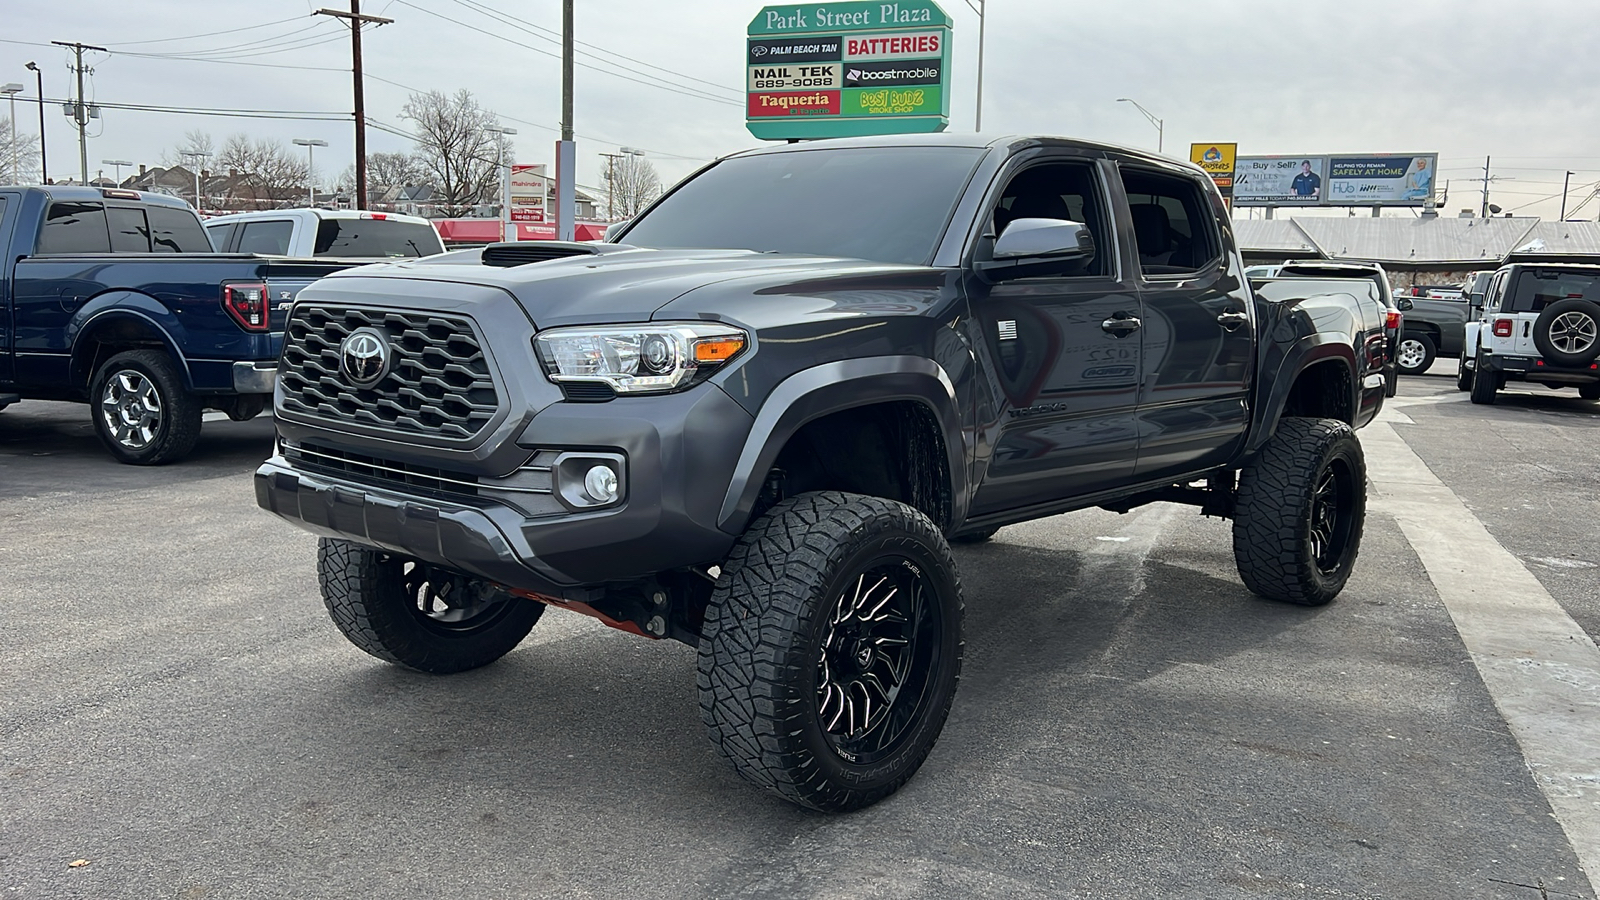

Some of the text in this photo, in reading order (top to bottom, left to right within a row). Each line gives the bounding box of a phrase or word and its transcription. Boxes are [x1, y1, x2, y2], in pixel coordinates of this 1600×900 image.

[766, 4, 931, 29] Park Street Plaza
[770, 43, 838, 55] PALM BEACH TAN
[848, 35, 939, 56] BATTERIES
[753, 65, 834, 79] NAIL TEK
[755, 77, 833, 89] 689-9088
[1253, 162, 1269, 170] Buy
[1277, 161, 1297, 169] Sell?
[902, 560, 921, 579] FUEL
[835, 744, 856, 762] FUEL
